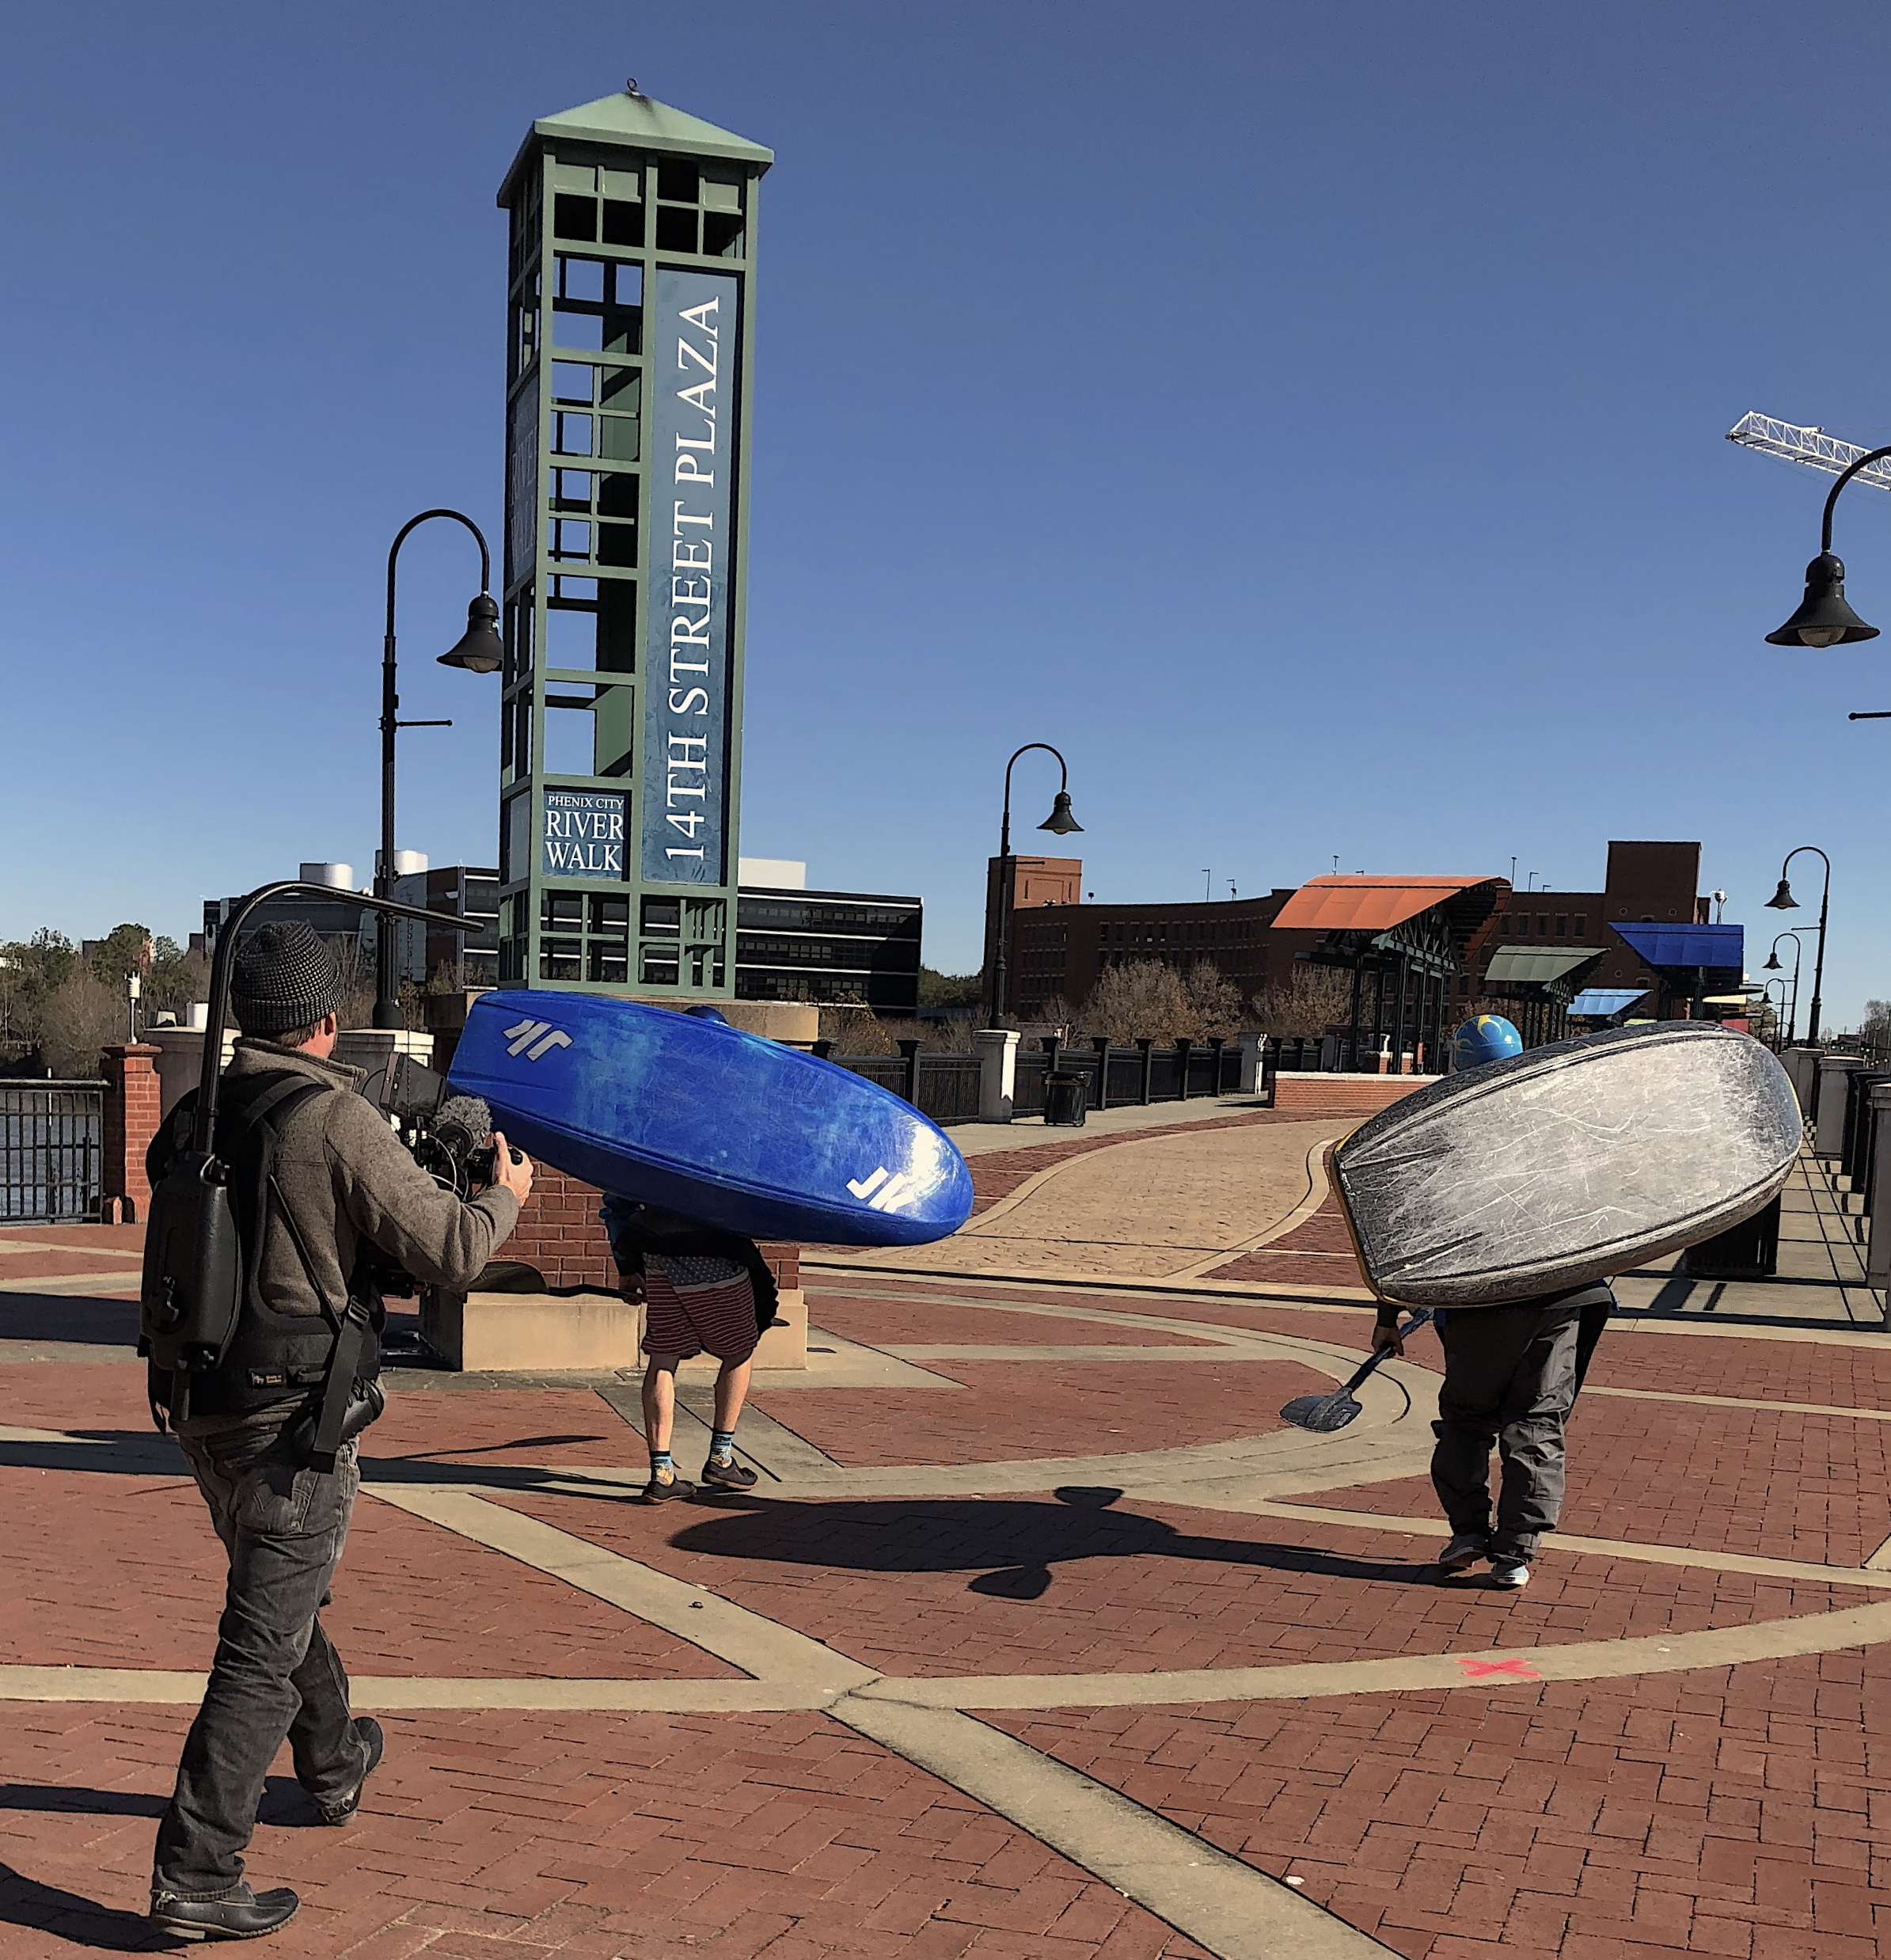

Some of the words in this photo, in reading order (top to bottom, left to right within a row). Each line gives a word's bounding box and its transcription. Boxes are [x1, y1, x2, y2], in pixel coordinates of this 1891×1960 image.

[674, 296, 719, 488] PLAZA
[668, 500, 713, 716] STREET
[545, 810, 624, 840] RIVER
[548, 795, 593, 808] PHENIX
[595, 797, 625, 810] CITY
[665, 731, 707, 861] 14TH
[545, 841, 622, 871] WALK
